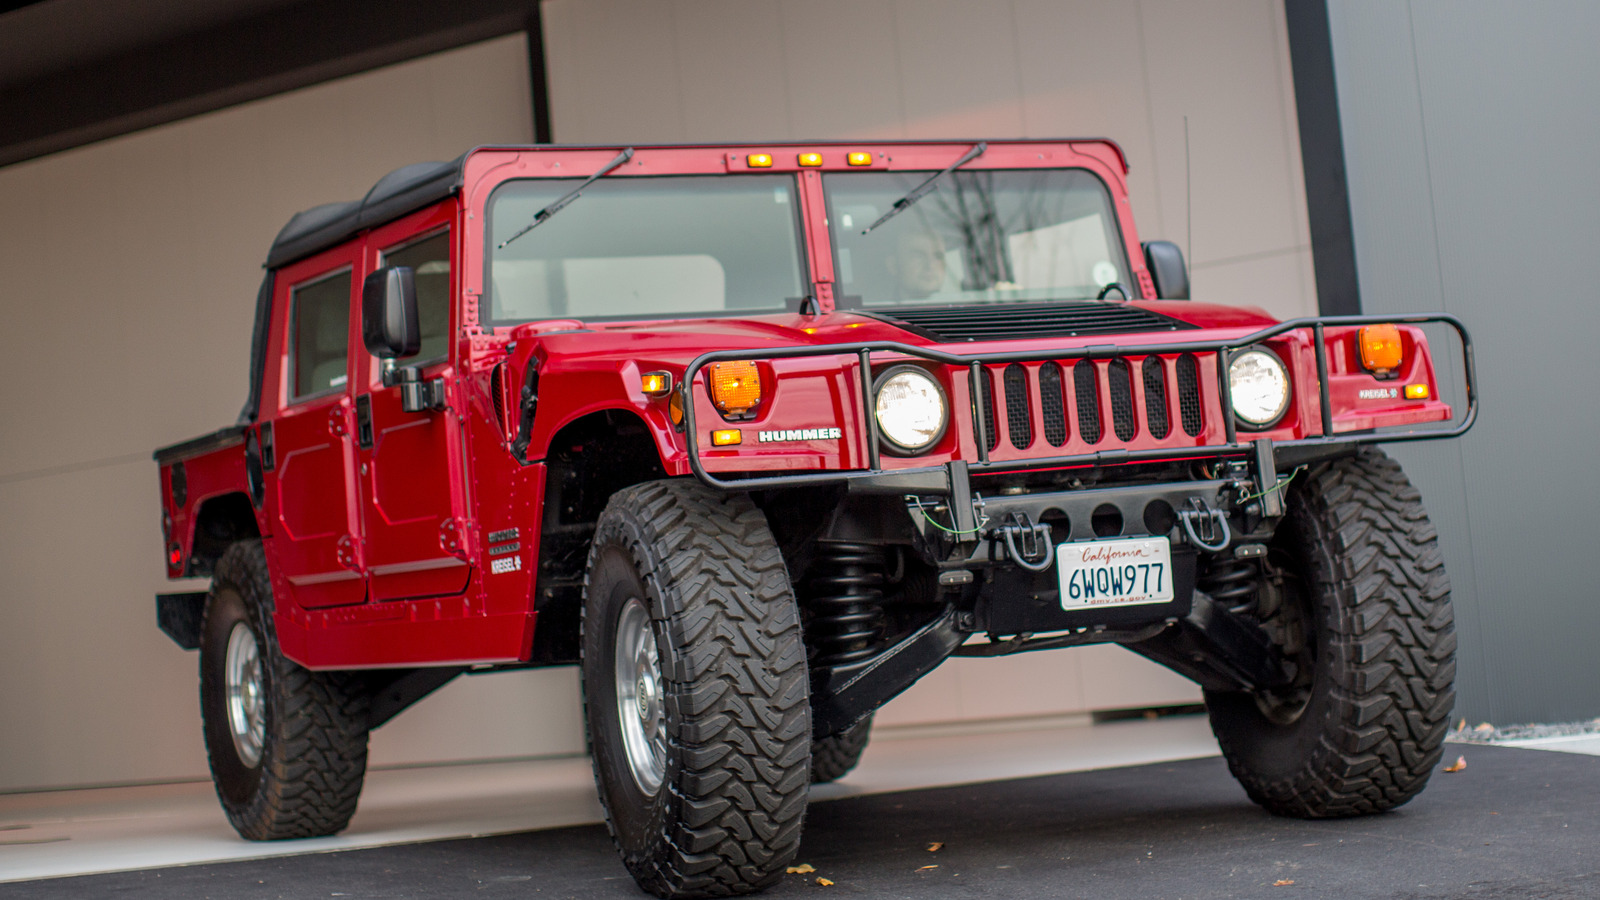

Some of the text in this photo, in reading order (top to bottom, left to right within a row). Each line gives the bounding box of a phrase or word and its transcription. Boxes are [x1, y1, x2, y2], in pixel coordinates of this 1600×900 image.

[1359, 388, 1390, 400] KREISEL
[758, 427, 842, 442] HUMMER
[1082, 546, 1149, 565] California
[491, 557, 516, 575] KREISEL
[1069, 563, 1163, 599] 6WQW977
